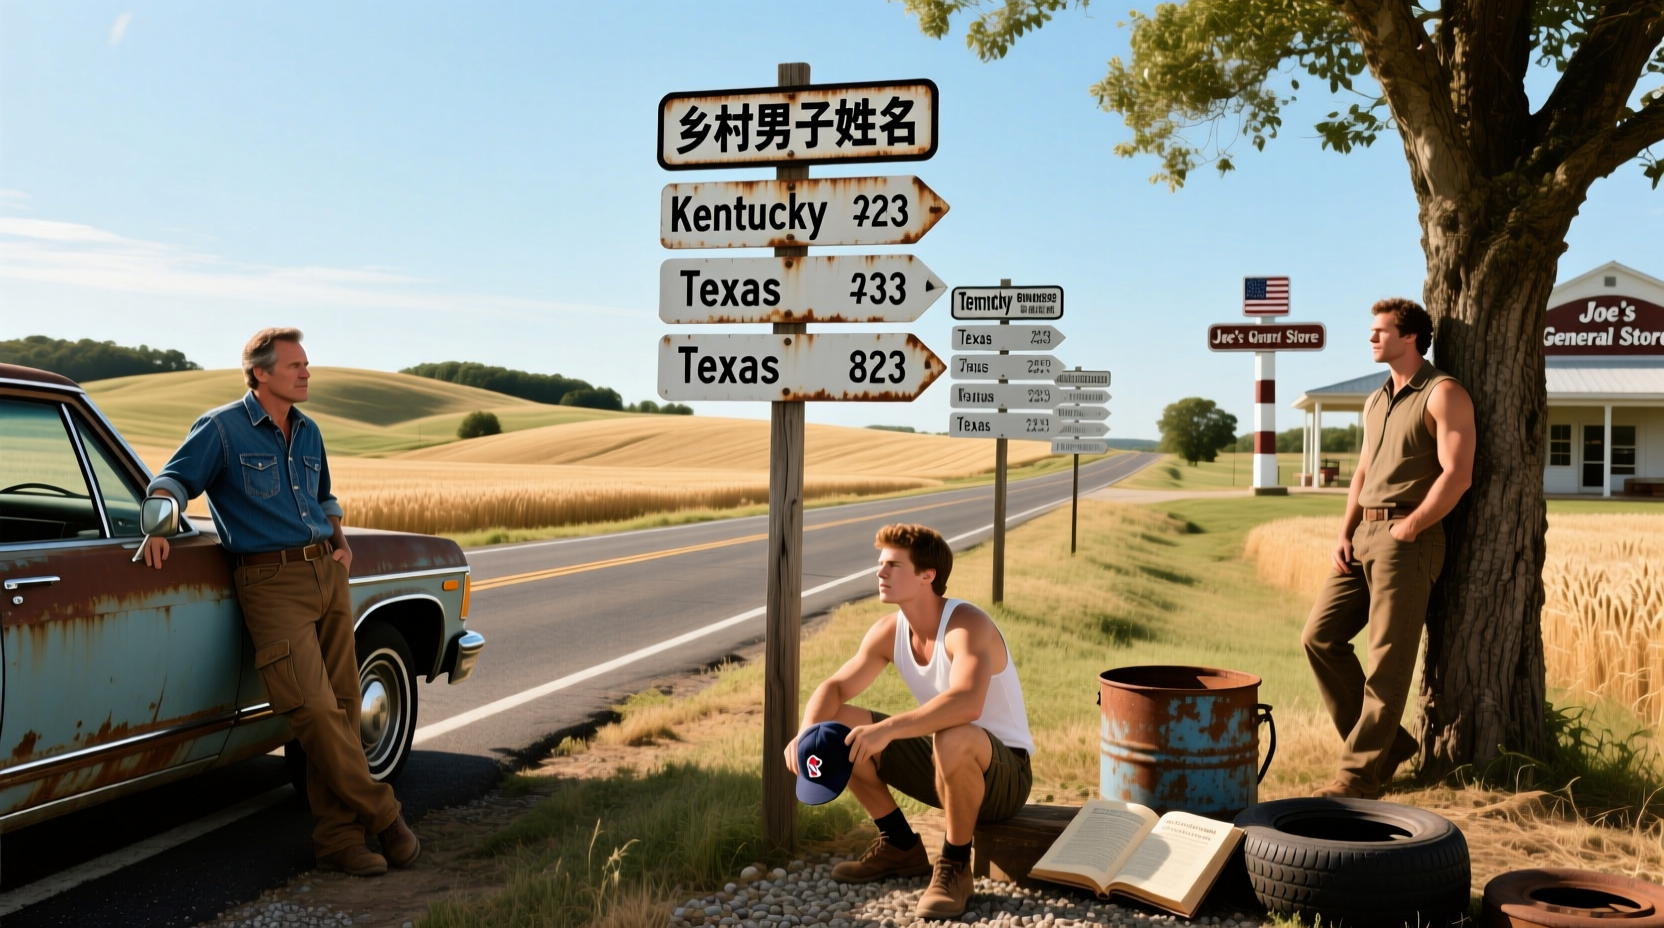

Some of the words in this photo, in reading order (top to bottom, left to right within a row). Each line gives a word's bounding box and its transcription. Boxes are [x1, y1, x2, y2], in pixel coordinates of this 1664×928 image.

[676, 96, 916, 155] 乡村男子姓名
[671, 192, 828, 241] Kentucky
[680, 270, 781, 307] Texas
[1579, 300, 1636, 323] Joe's
[957, 329, 992, 345] Texas
[1543, 326, 1614, 347] General
[678, 346, 780, 384] Texas
[849, 350, 906, 384] 823
